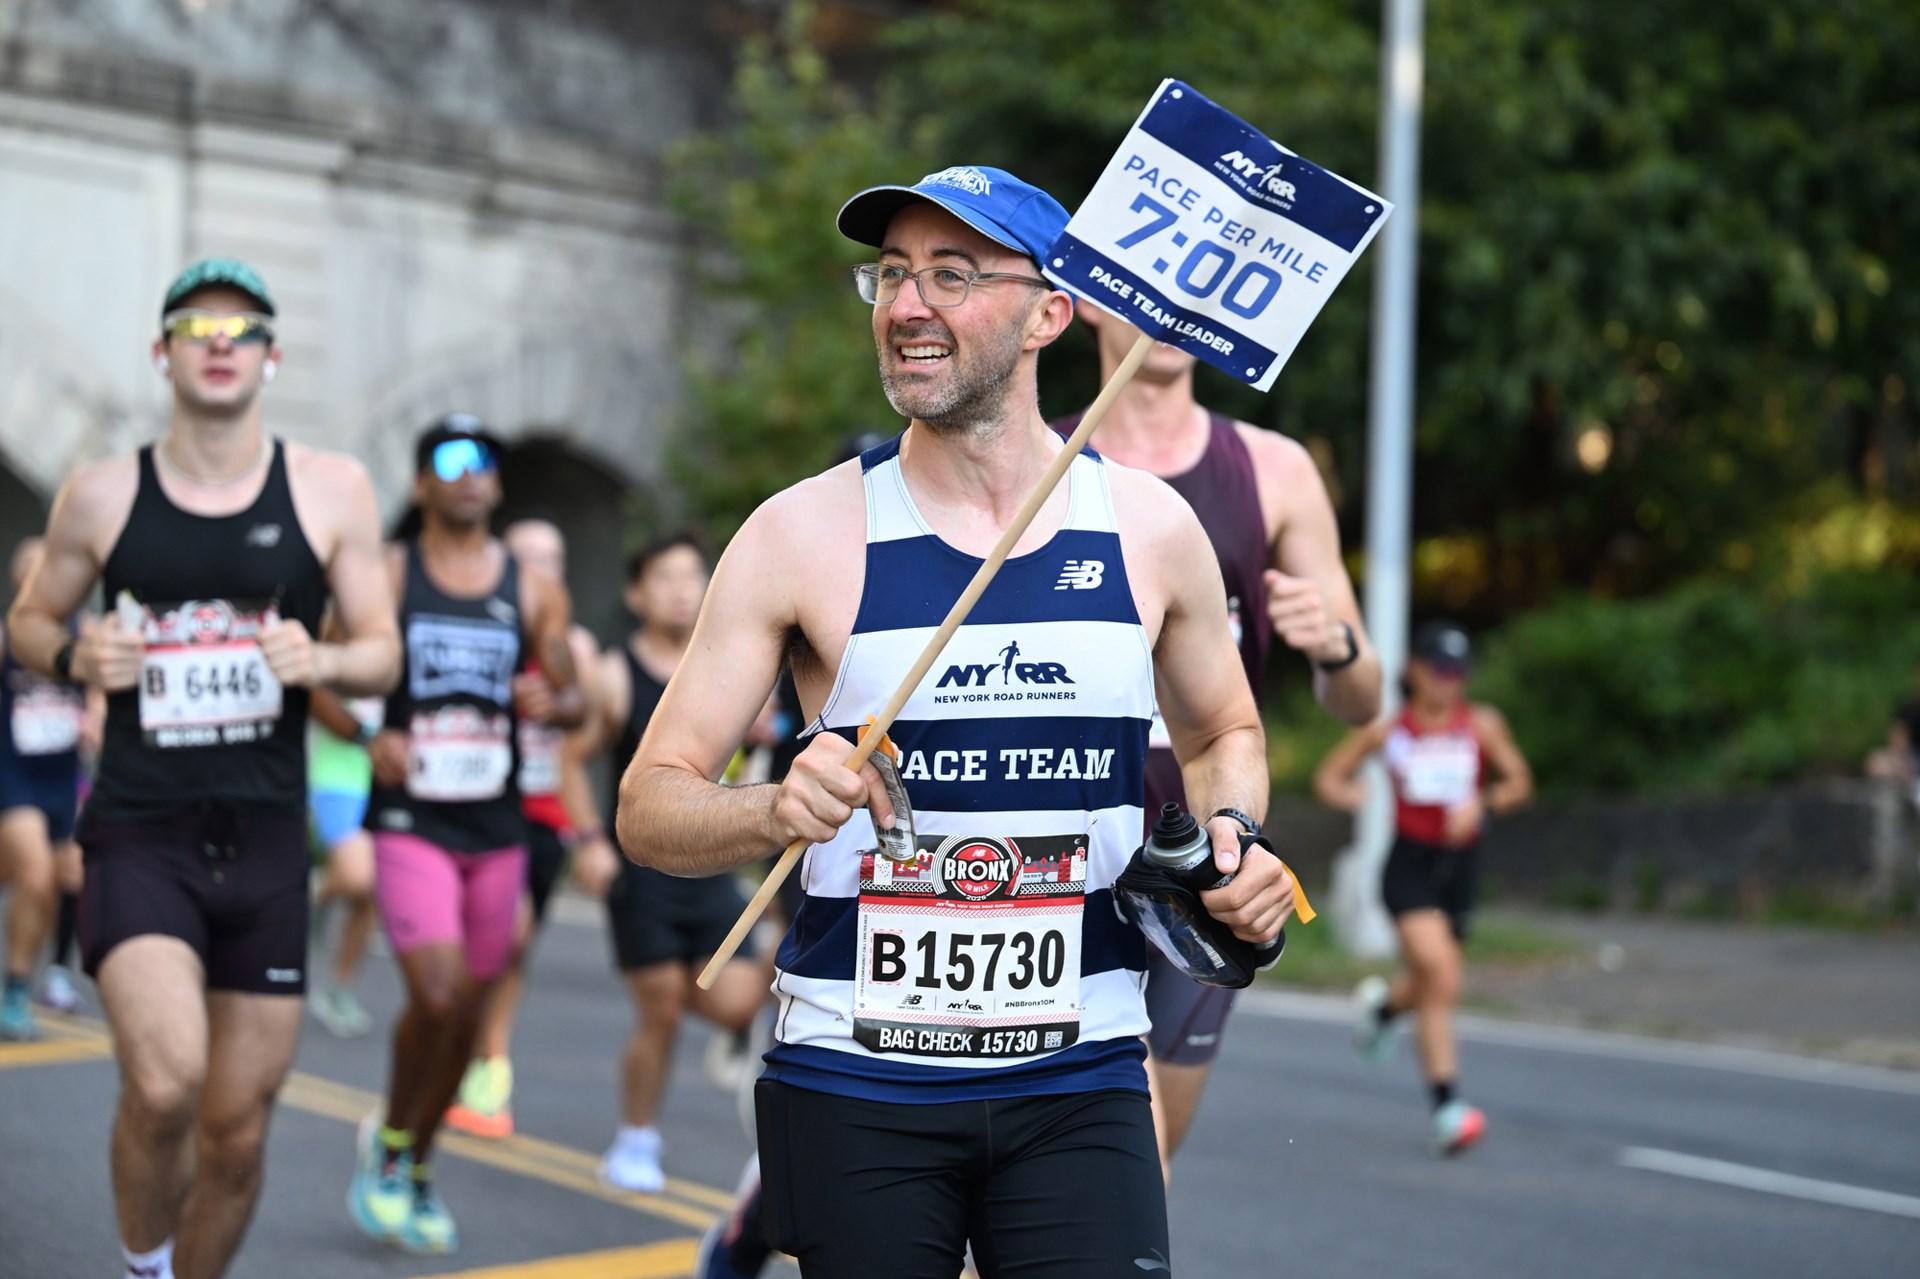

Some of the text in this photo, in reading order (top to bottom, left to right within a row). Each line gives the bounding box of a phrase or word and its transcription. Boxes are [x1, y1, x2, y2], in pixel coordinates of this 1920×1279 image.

[1214, 161, 1231, 174] NEW
[1230, 172, 1248, 188] YORK
[1246, 186, 1264, 199] ROAD
[1123, 154, 1329, 284] PACE PER MILE
[1114, 192, 1283, 320] 7:00
[1089, 266, 1235, 356] PACE TEAM LEADER
[1054, 560, 1105, 591] NB
[185, 660, 262, 700] 6446
[934, 691, 1077, 704] NEW YORK ROAD RUNNERS
[1000, 748, 1116, 781] TEAM
[944, 858, 1011, 882] BRONX
[964, 883, 990, 892] 10 MILE
[872, 929, 1066, 992] B 15730
[1005, 999, 1055, 1008] #NBBronx10M
[879, 1028, 1038, 1053] BAG CHECK 15730
